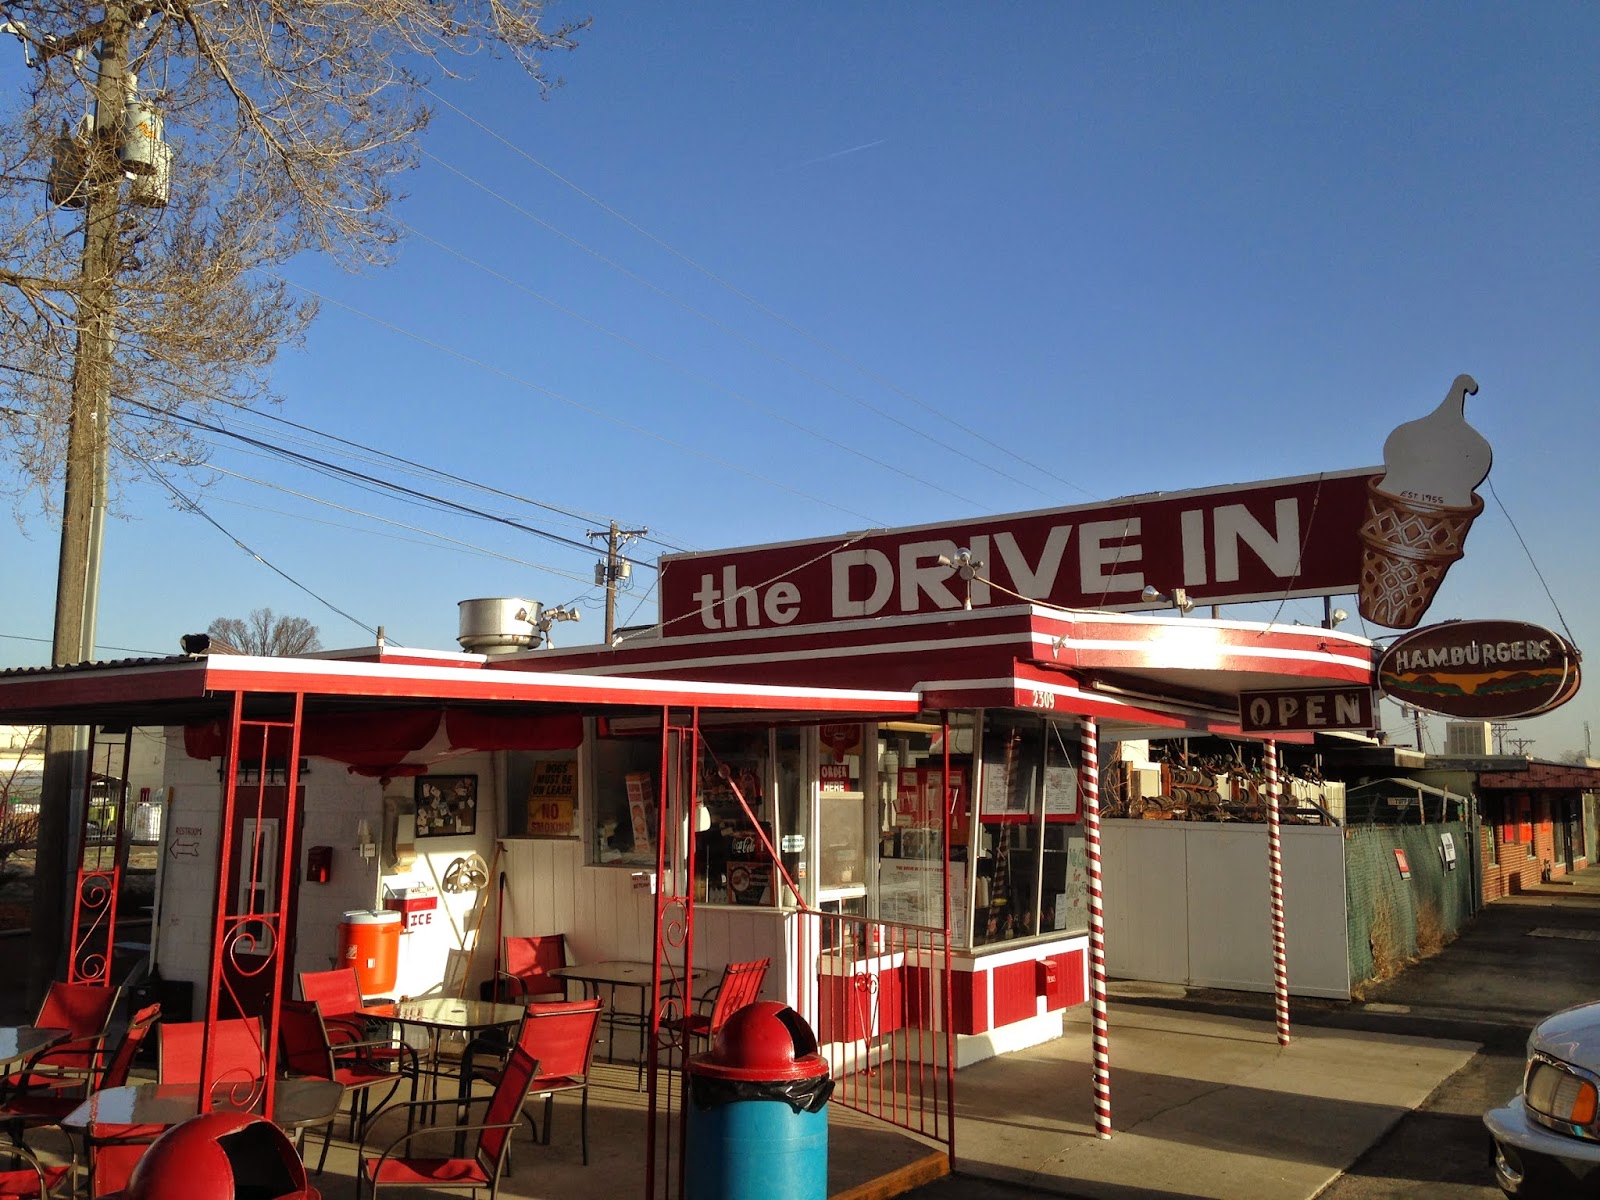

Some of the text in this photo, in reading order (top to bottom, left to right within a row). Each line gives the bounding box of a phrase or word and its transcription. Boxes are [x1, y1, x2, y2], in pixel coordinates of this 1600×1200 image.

[1421, 494, 1444, 503] 1955
[693, 497, 1301, 629] the DRIVE IN
[1395, 639, 1552, 673] HAMBURGERS
[1032, 689, 1055, 709] 2309
[1250, 694, 1361, 726] OPEN
[545, 763, 568, 773] DOGS
[821, 765, 847, 778] ORDER
[536, 774, 574, 784] MUST BE
[532, 785, 573, 795] ON LEASH
[823, 781, 845, 792] HERE
[541, 803, 559, 820] NO
[176, 826, 202, 835] RESTROOM
[531, 821, 570, 832] SMOKING
[410, 913, 432, 927] ICE
